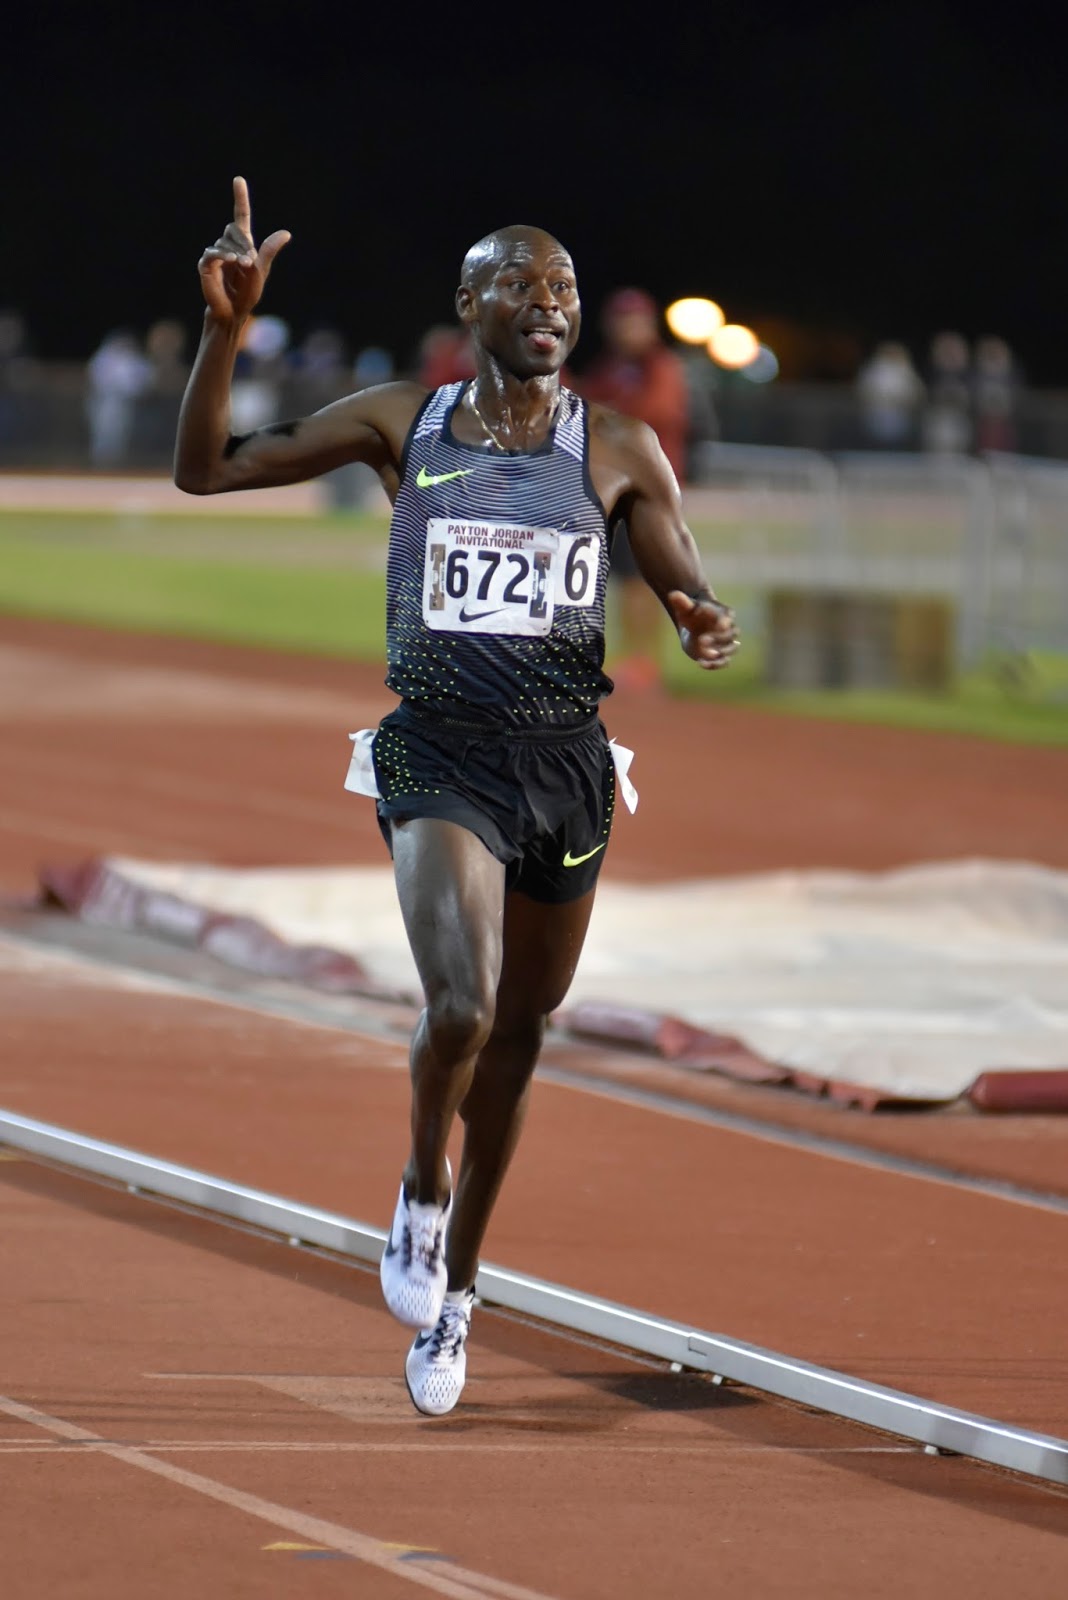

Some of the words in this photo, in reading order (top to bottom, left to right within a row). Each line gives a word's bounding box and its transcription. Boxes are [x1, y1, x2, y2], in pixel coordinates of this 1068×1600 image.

[447, 524, 489, 537] PAYTON
[491, 528, 535, 541] JORDAN
[455, 536, 525, 550] INVITATIONAL
[446, 549, 530, 604] 672
[564, 536, 592, 601] 6
